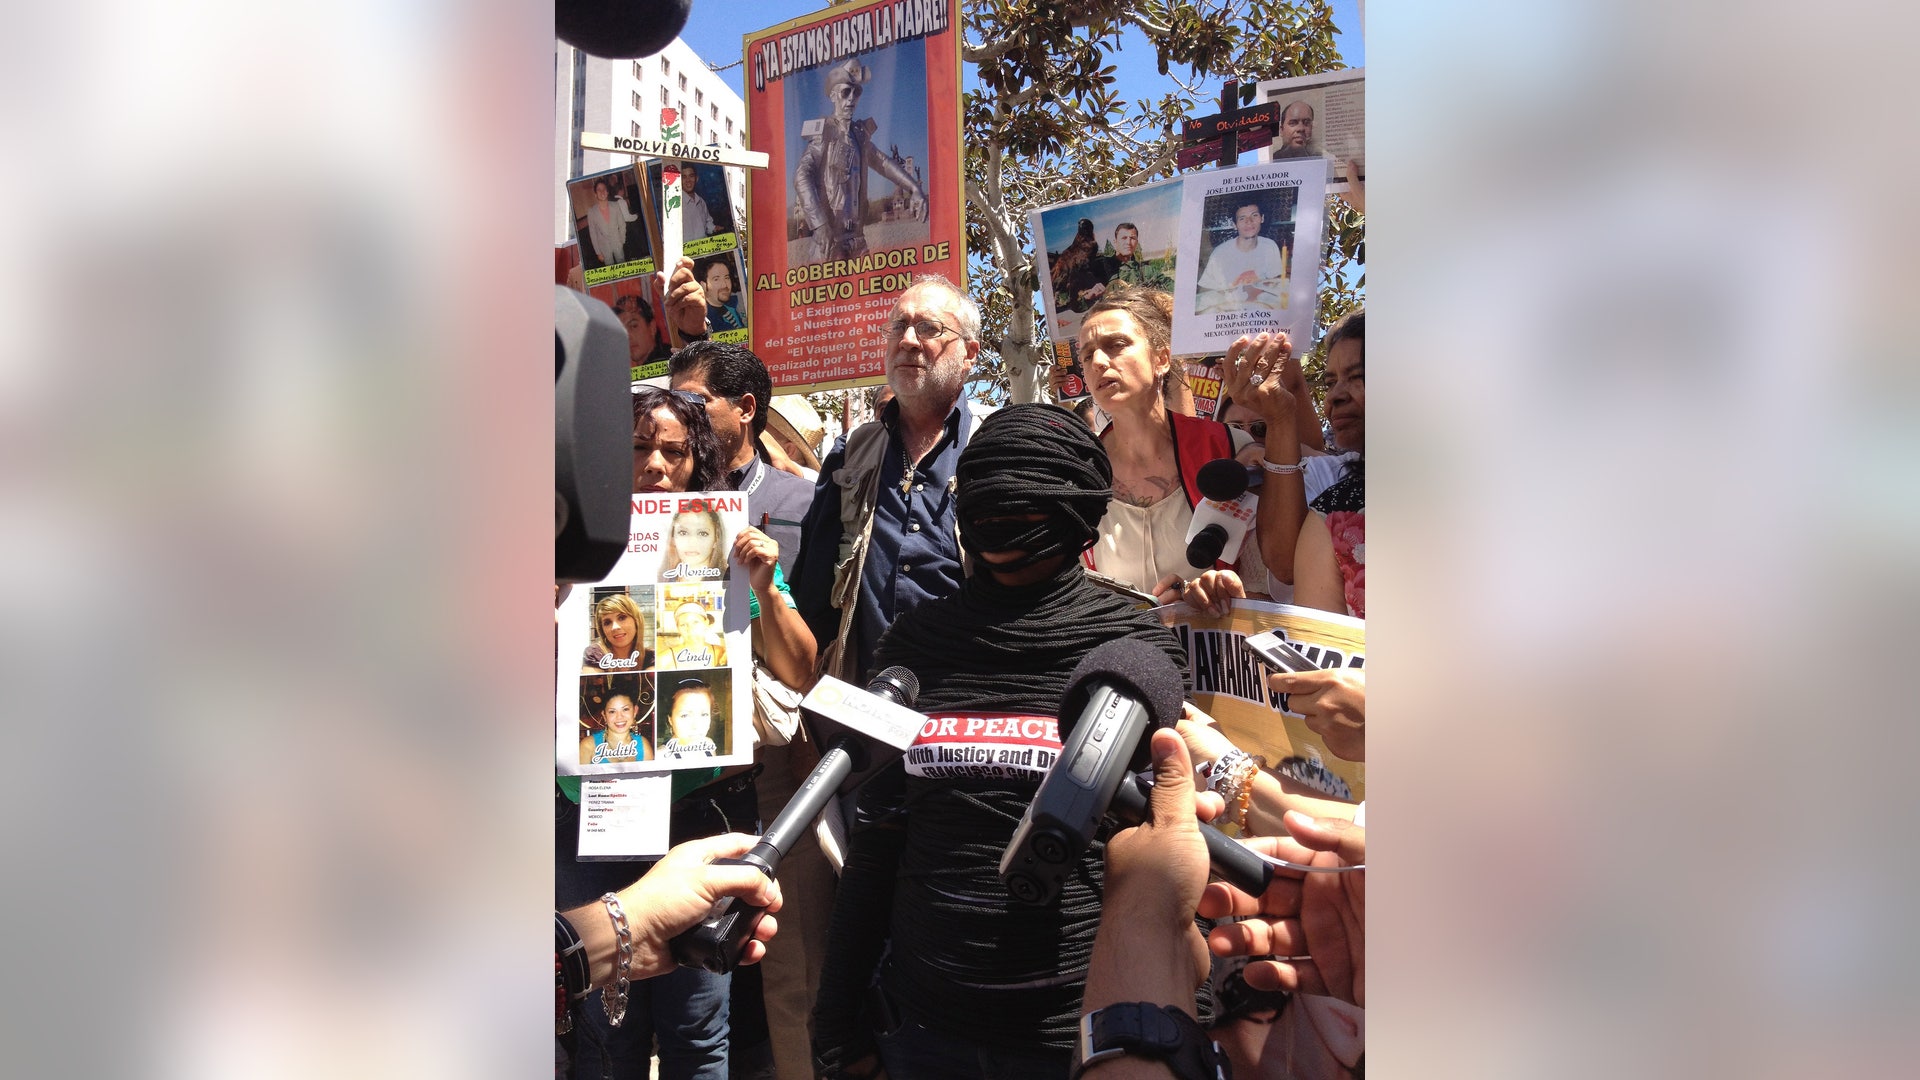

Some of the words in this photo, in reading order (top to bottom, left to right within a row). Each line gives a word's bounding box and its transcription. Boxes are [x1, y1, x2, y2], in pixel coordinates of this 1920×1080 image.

[780, 24, 832, 74] ESTAMOS
[833, 12, 874, 58] HASTA
[876, 6, 892, 46] LA
[1188, 120, 1202, 130] No
[1216, 112, 1271, 131] Olvidados
[1245, 172, 1289, 182] SALVADOR
[1205, 187, 1224, 195] JOSE
[1225, 182, 1264, 192] LEONIDAS
[1265, 179, 1302, 188] MORENO
[756, 274, 781, 291] AL
[785, 248, 917, 286] GOBERNADOR
[923, 242, 950, 263] DE
[790, 283, 853, 307] NUEVO
[858, 271, 912, 296] LEON
[791, 311, 803, 320] Le
[806, 302, 861, 318] Exigimos
[1215, 313, 1238, 321] EDAD:
[1249, 310, 1271, 318] AÑOS
[803, 317, 851, 331] Nuestro
[1215, 320, 1267, 329] DESAPARECIDO
[765, 338, 784, 348] del
[787, 331, 845, 346] Secuestro
[849, 327, 863, 337] de
[806, 341, 856, 355] Vaquero
[767, 358, 819, 371] realizado
[823, 356, 843, 367] por
[847, 353, 857, 362] la
[782, 371, 799, 382] las
[803, 366, 855, 380] Patrullas
[859, 361, 881, 373] 534
[678, 498, 742, 514] ESTAN
[627, 544, 658, 553] LEON
[600, 651, 640, 668] Coral
[676, 647, 712, 666] Cindy
[964, 718, 1062, 742] PEACE
[592, 740, 637, 763] Judith
[664, 739, 717, 758] Juanita
[907, 745, 935, 766] With
[937, 745, 996, 764] Justicy
[1000, 748, 1034, 766] and
